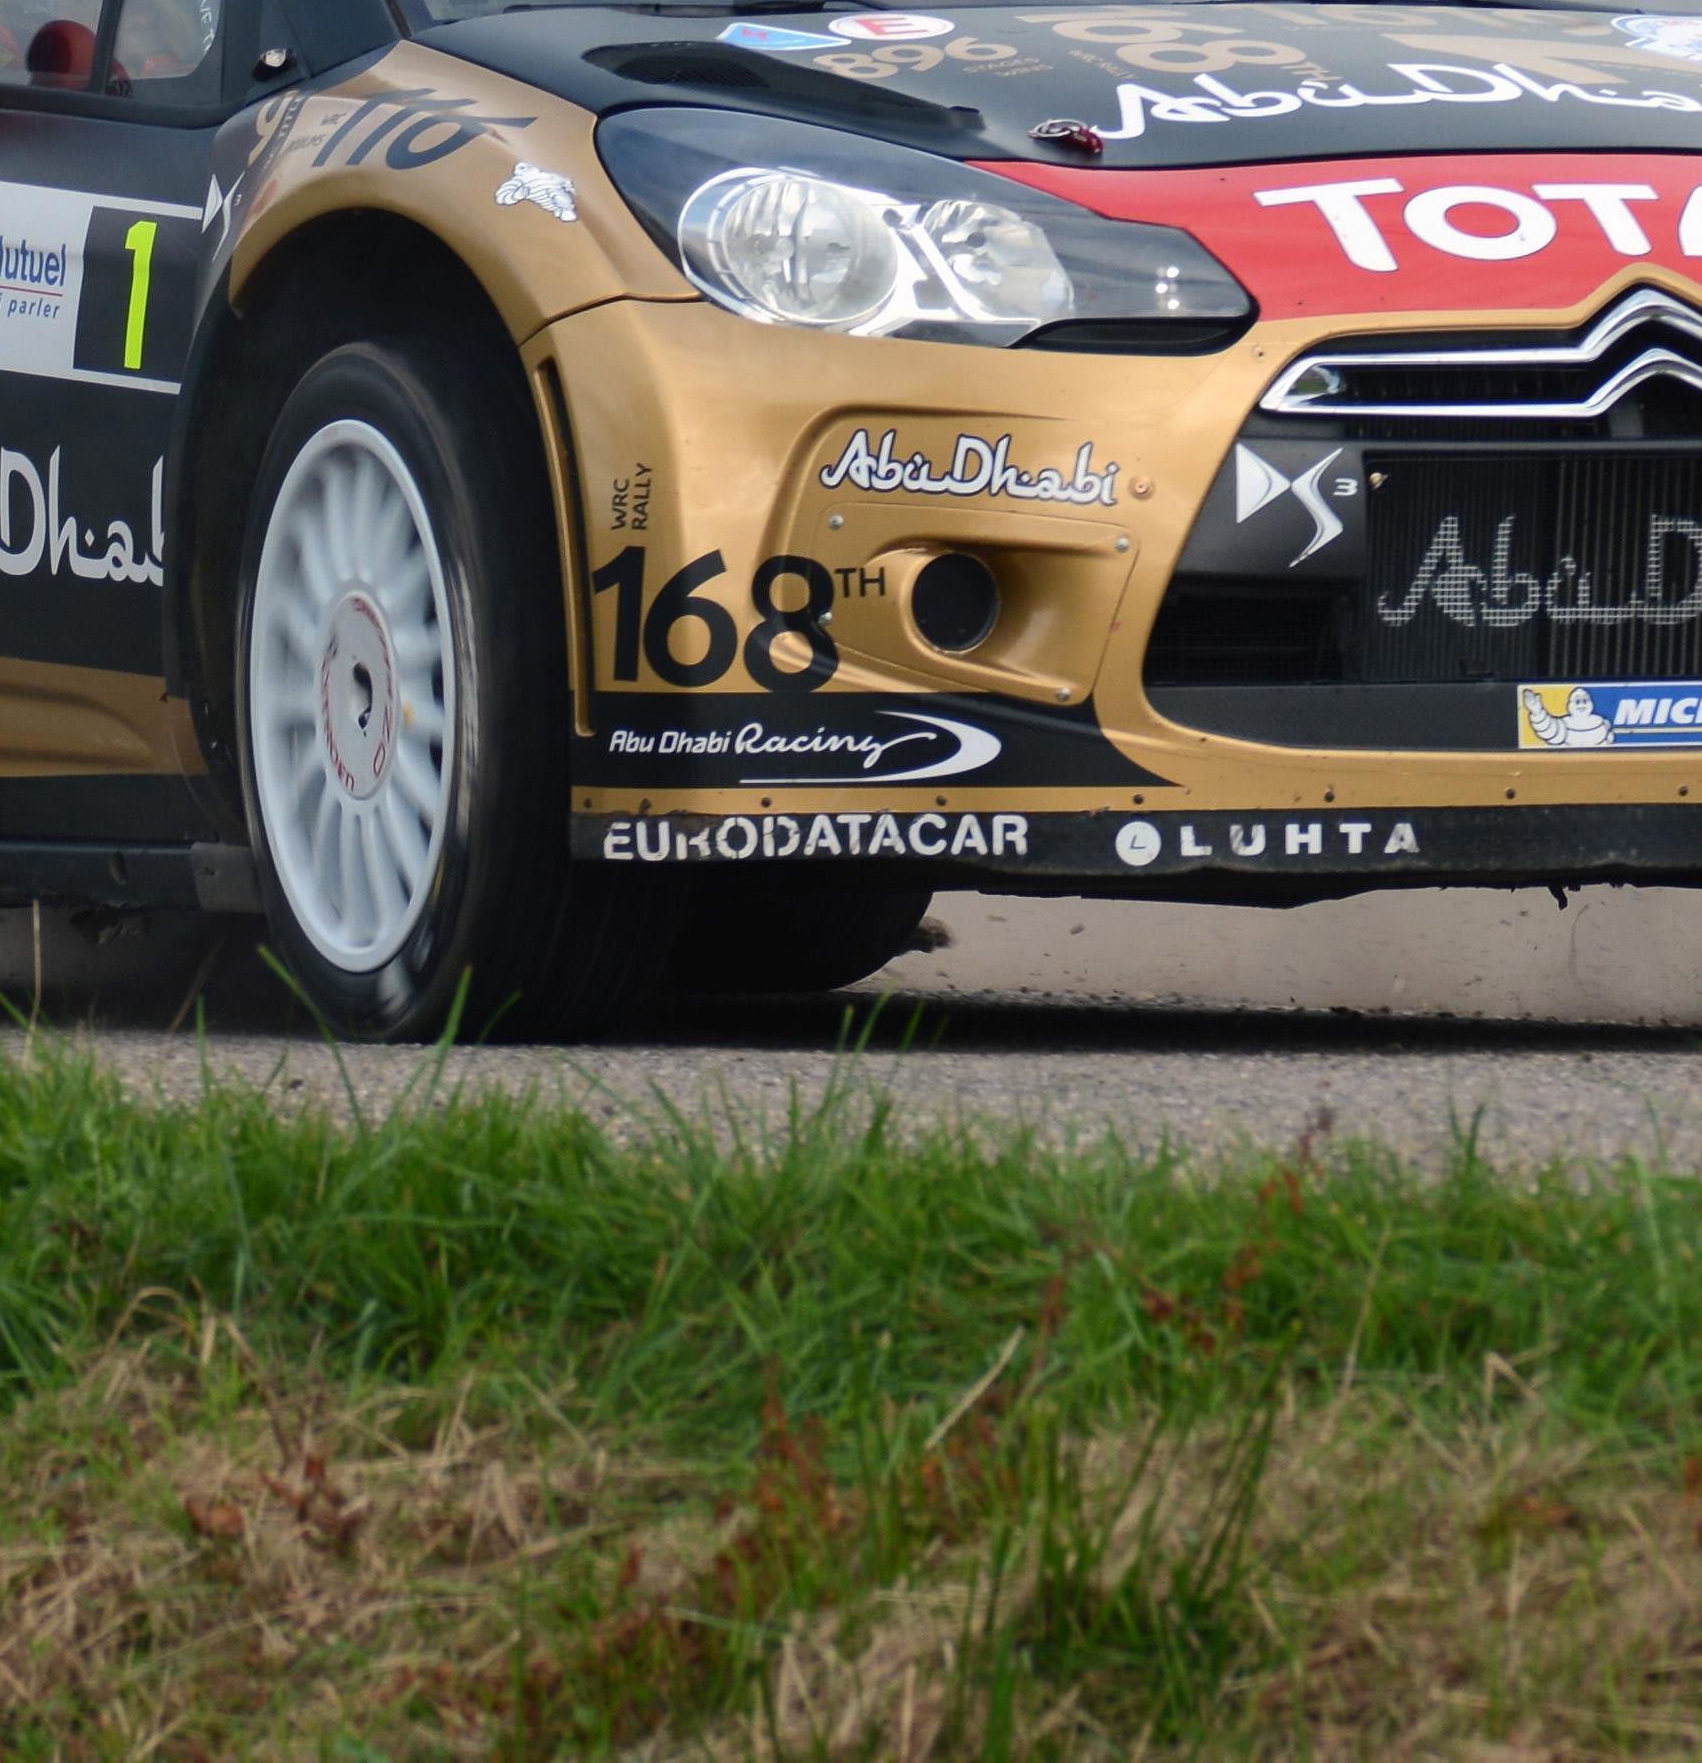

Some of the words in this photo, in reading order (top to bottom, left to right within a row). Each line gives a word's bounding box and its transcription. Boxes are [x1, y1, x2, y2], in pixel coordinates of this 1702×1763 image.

[813, 36, 1018, 79] 896
[7, 297, 61, 320] parler
[123, 220, 158, 370] 1
[611, 478, 629, 531] WRC
[631, 462, 653, 531] RALLY
[609, 729, 655, 754] Abu
[658, 730, 732, 755] Dhabi
[735, 722, 939, 769] Racing
[602, 812, 1029, 863] EURODATACAR
[1179, 822, 1421, 857] LUHTA
